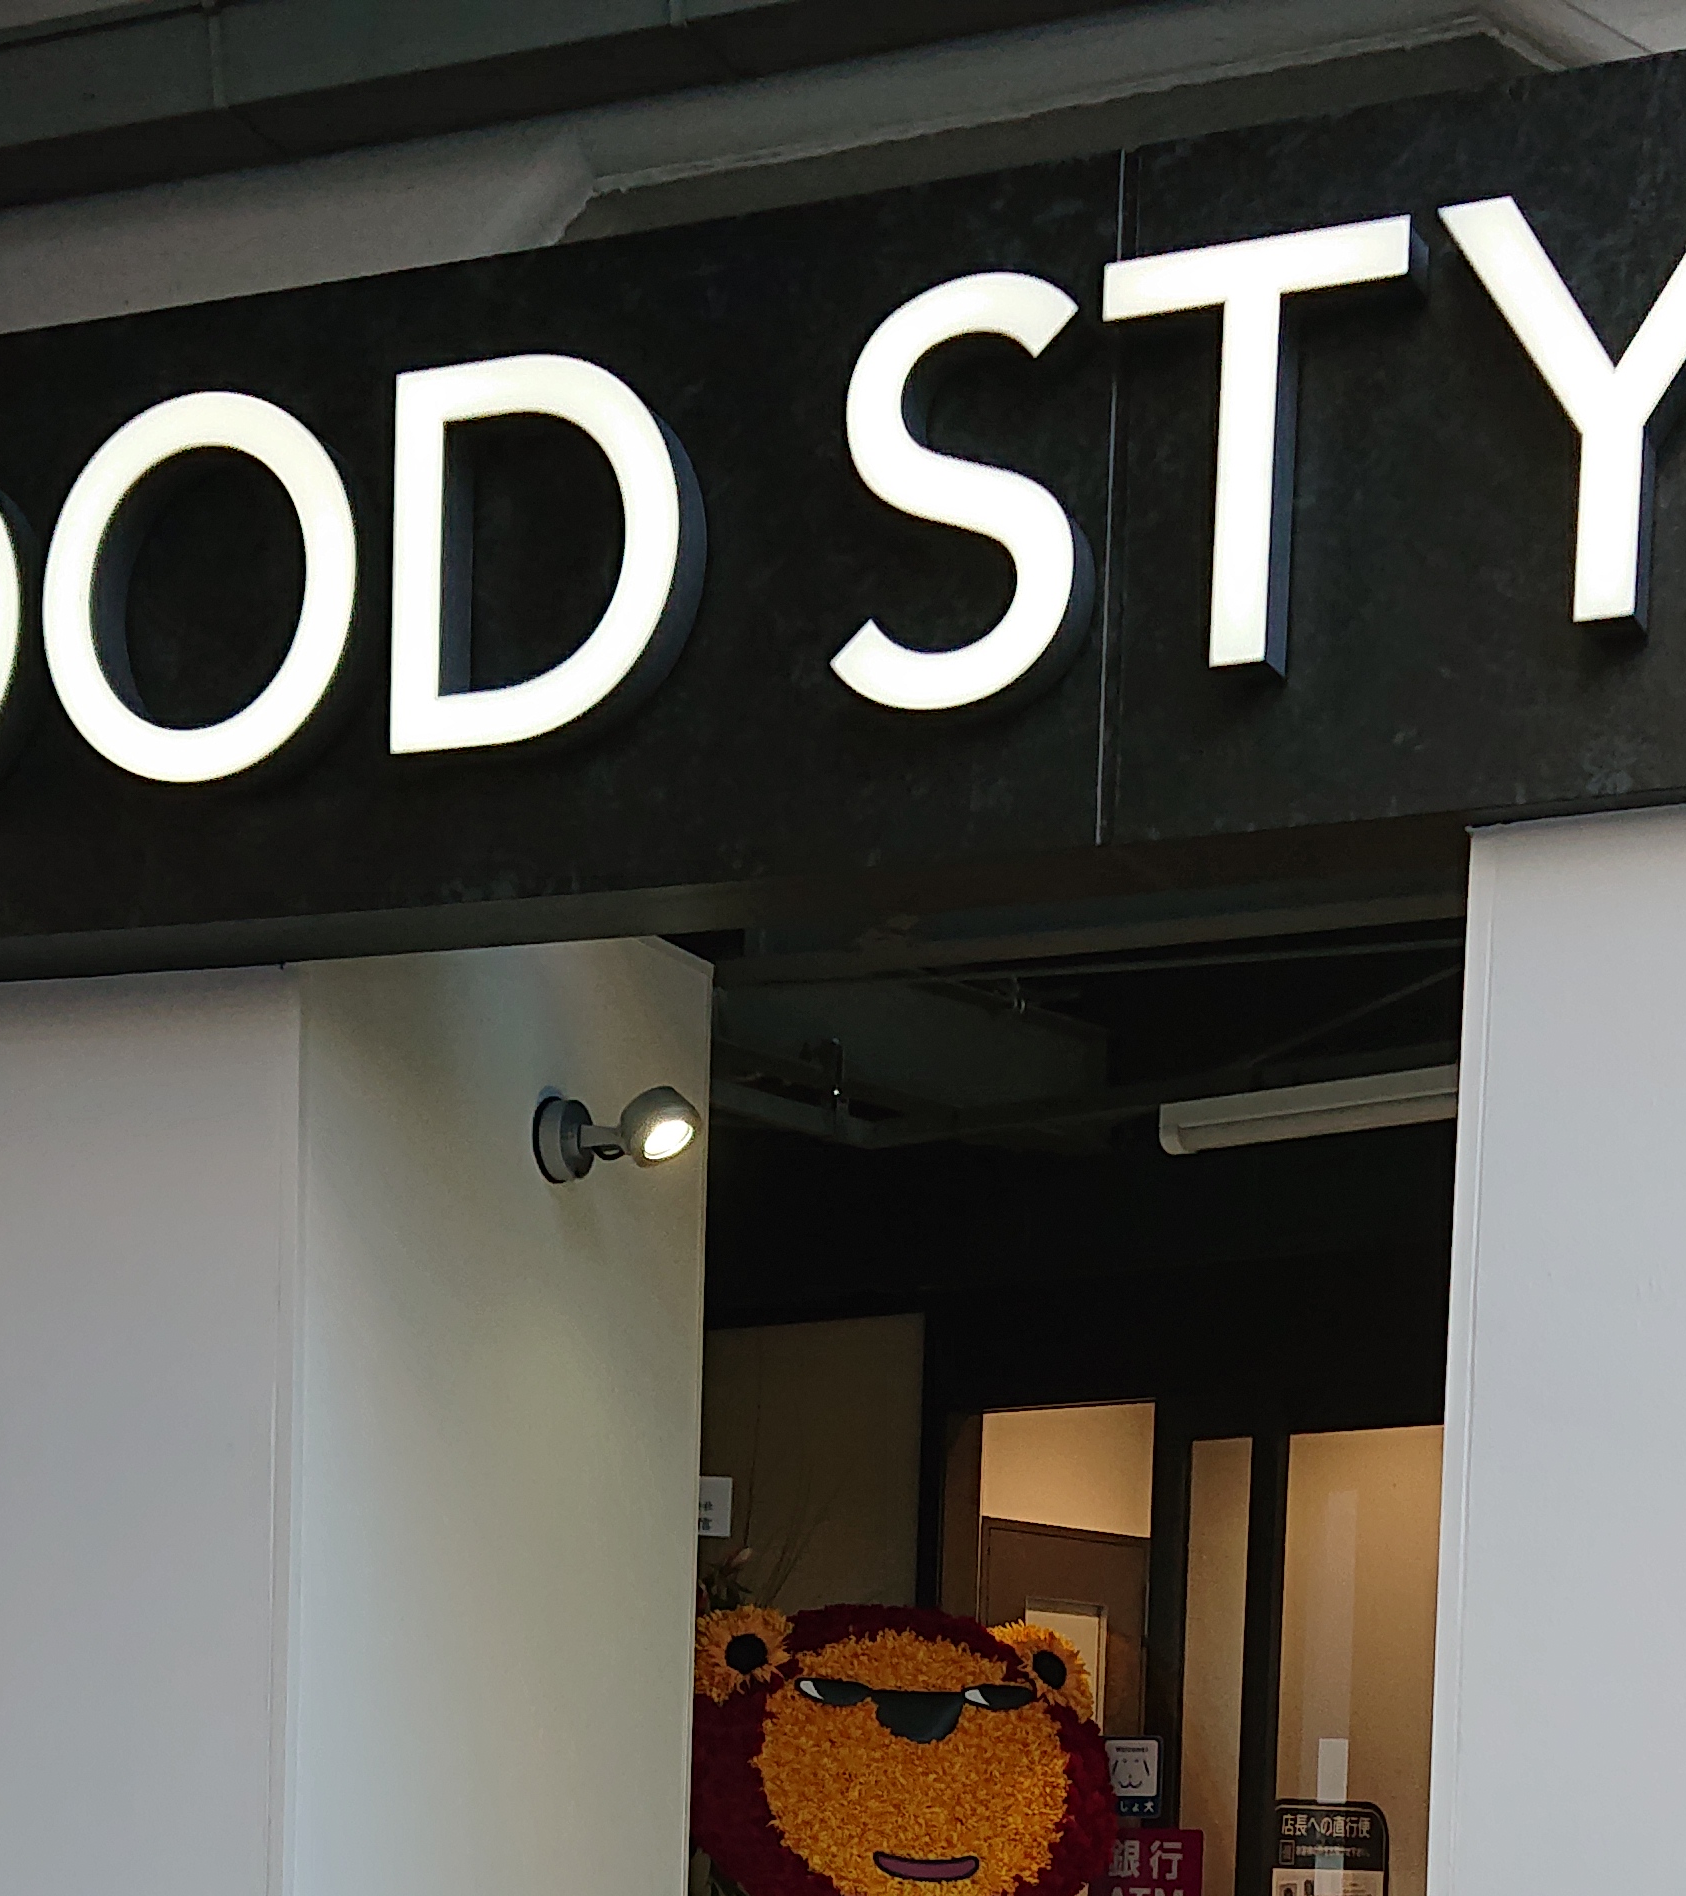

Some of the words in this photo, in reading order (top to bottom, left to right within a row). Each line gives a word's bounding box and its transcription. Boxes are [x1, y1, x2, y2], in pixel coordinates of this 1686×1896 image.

[1281, 1814, 1372, 1838] 店長への直行便
[1108, 1839, 1183, 1881] 銀行
